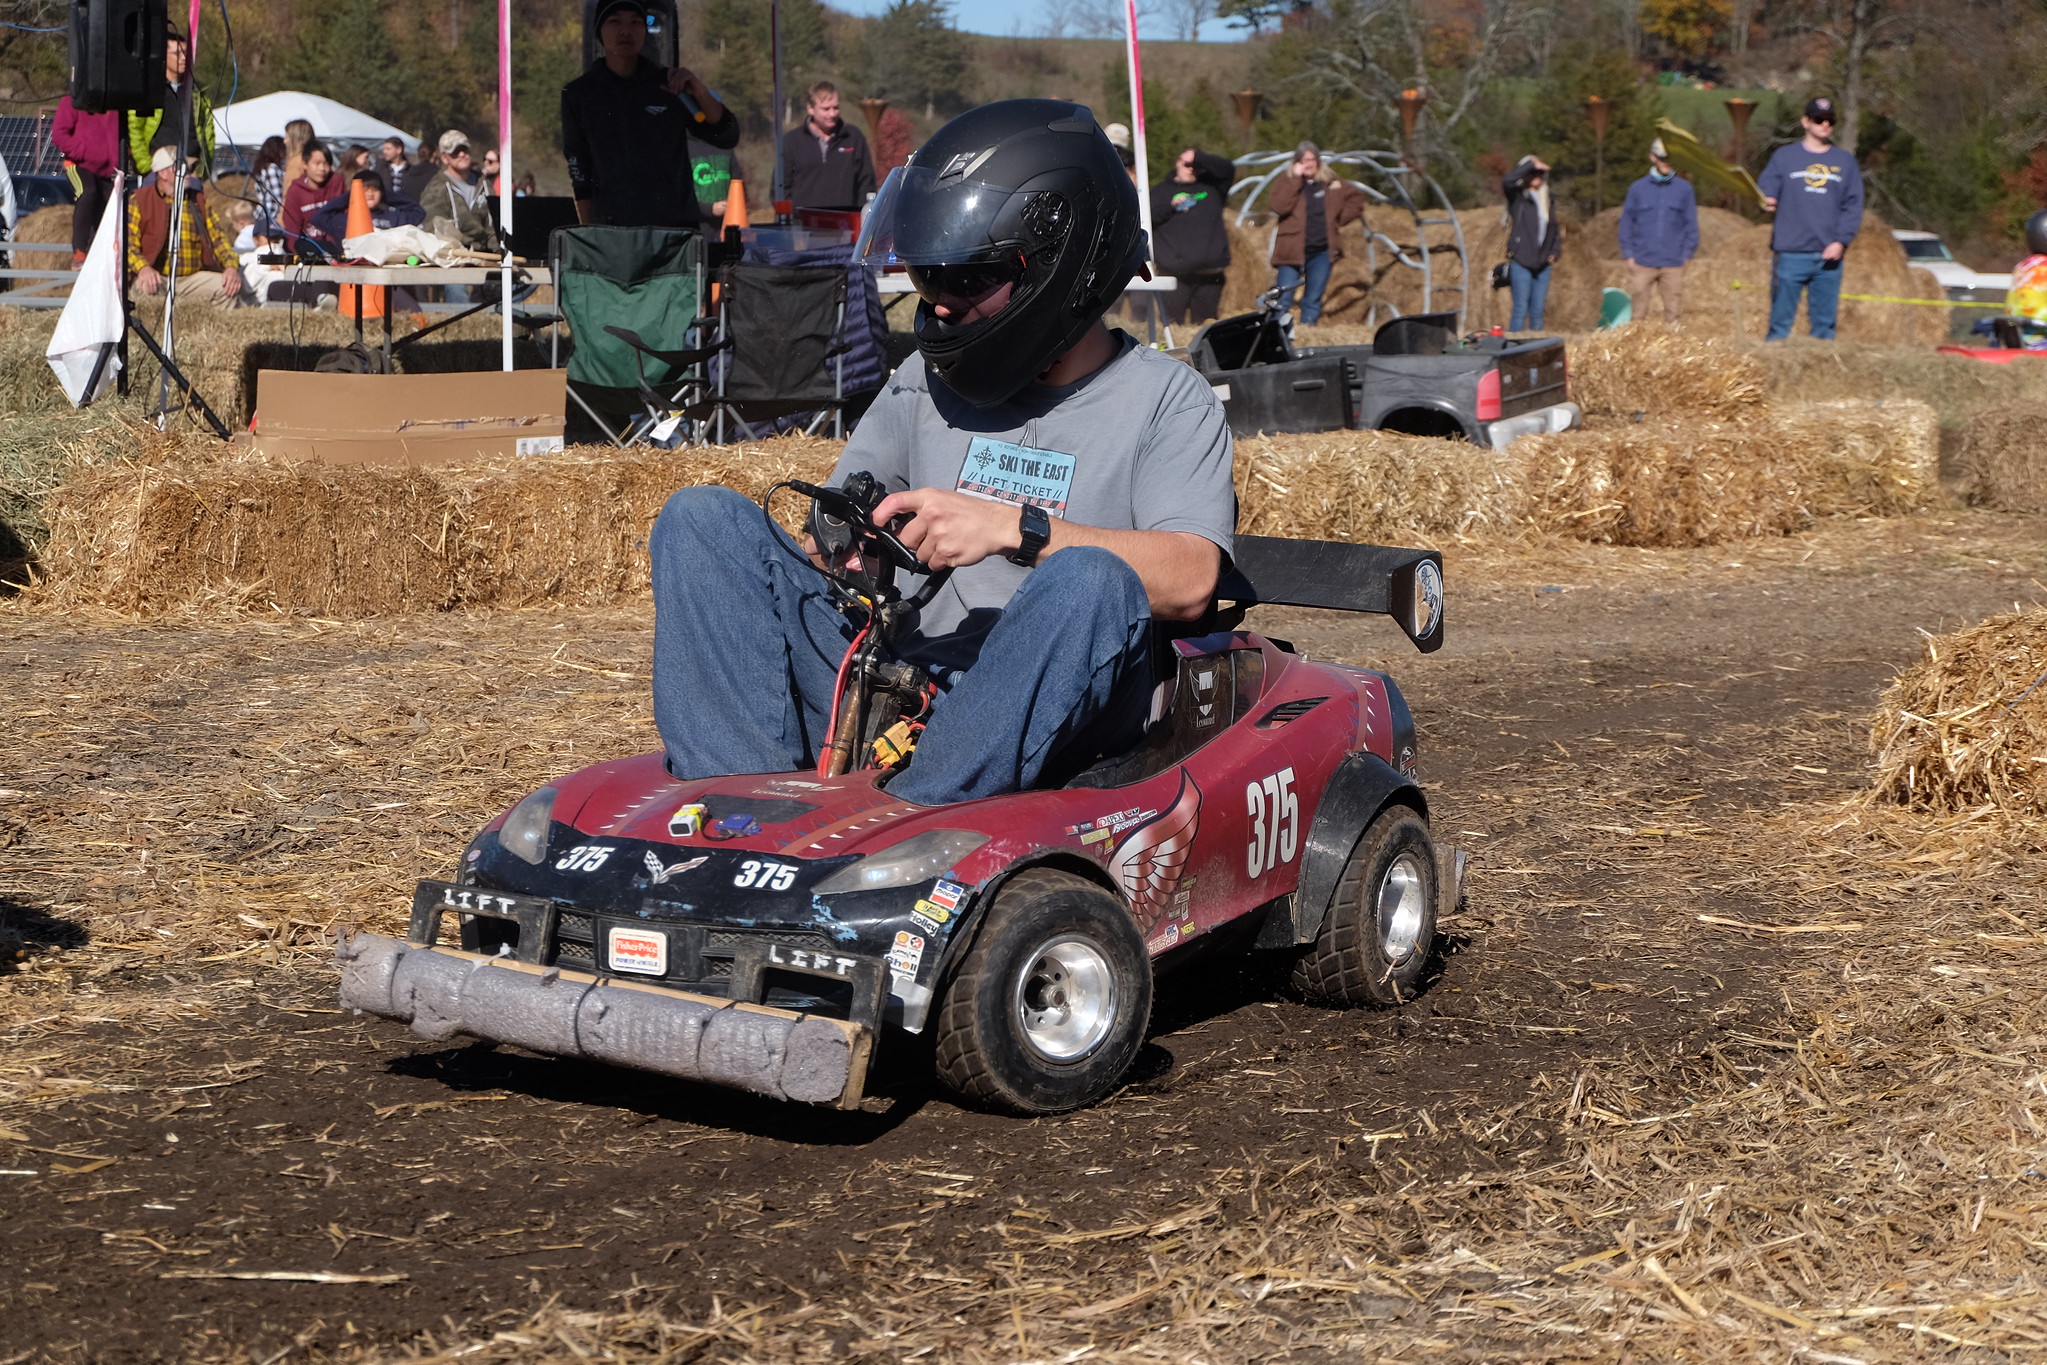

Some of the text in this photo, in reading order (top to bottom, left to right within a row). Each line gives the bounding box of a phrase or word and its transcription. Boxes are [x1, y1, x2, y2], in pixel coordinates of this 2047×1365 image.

[999, 453, 1069, 482] SKI THE EAST
[980, 474, 1008, 489] LIFT
[1013, 481, 1052, 498] TICKET
[1246, 766, 1299, 879] 375
[555, 846, 615, 872] 375
[734, 860, 799, 890] 375
[444, 888, 516, 914] LIFT
[935, 888, 958, 899] mopar
[769, 945, 857, 975] LIFT
